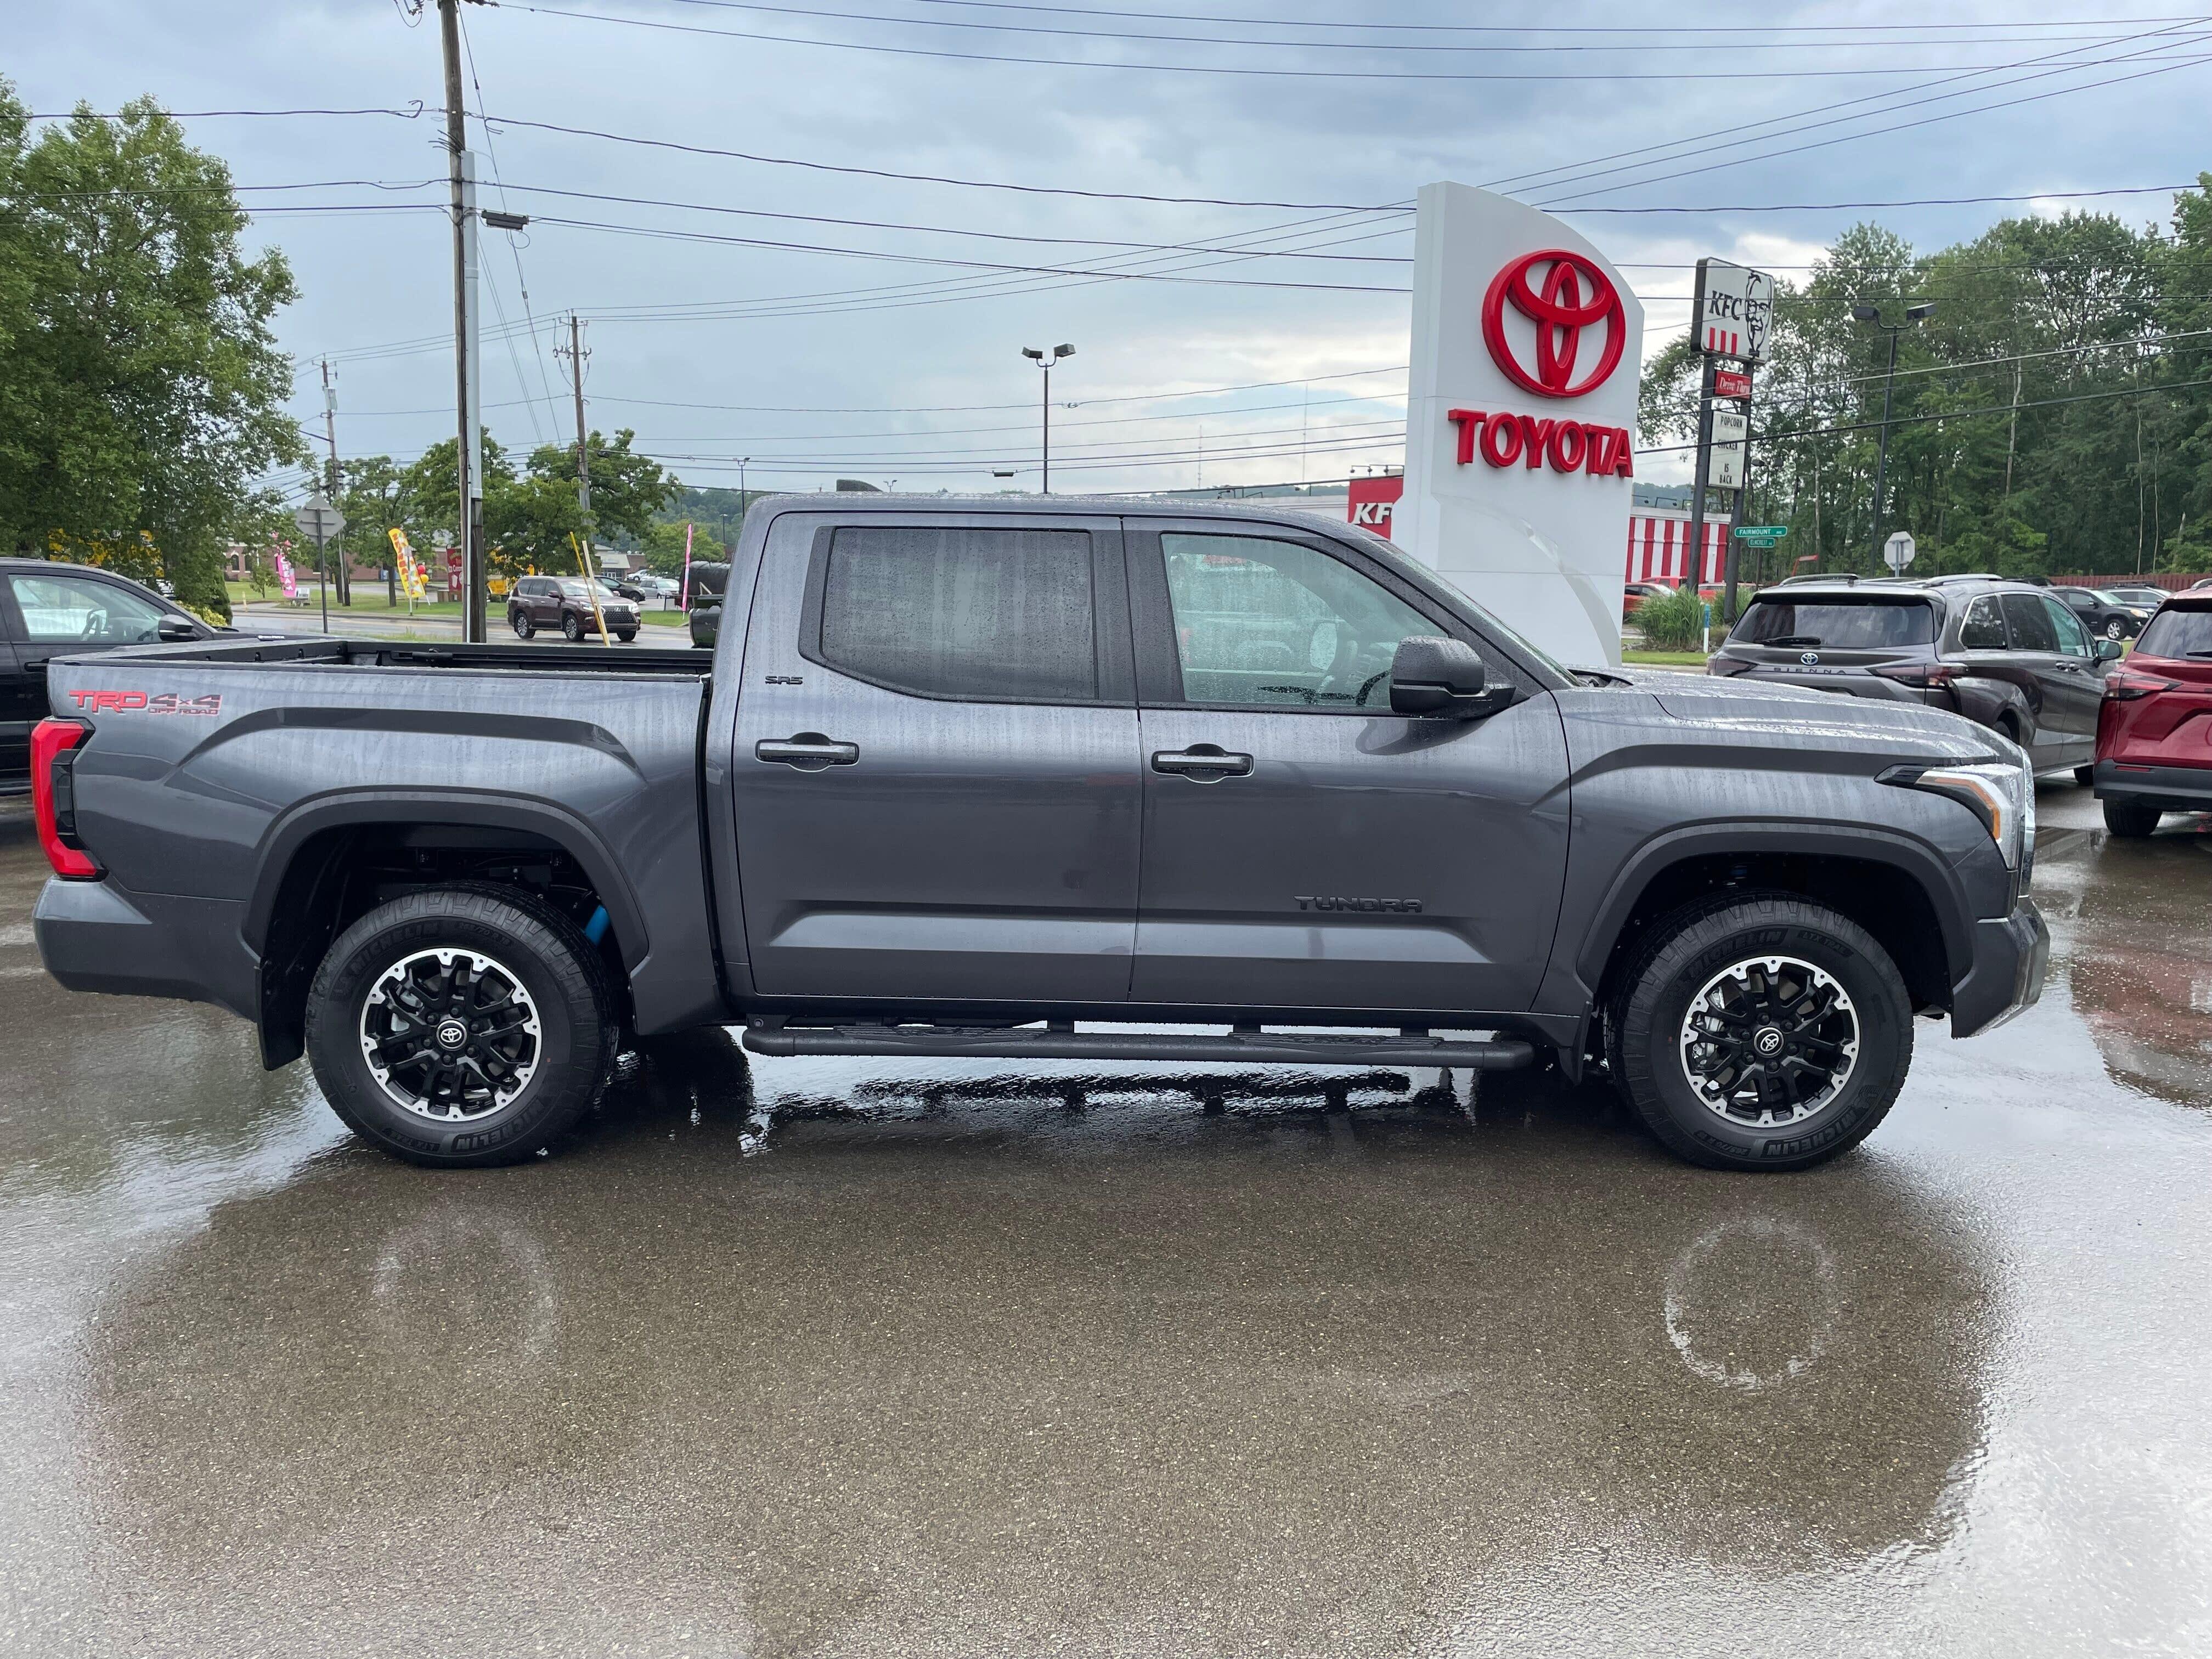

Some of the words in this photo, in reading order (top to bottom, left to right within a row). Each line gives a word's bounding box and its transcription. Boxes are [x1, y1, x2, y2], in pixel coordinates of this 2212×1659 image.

[1709, 290, 1742, 321] KFC
[1720, 377, 1735, 391] Drive
[1720, 416, 1742, 428] POPCORN
[1448, 409, 1633, 478] TOYOTA
[1724, 463, 1729, 472] IS
[1719, 475, 1732, 484] BACK
[1351, 503, 1393, 524] KF
[765, 675, 803, 685] SR5
[69, 690, 149, 714] TRD
[1293, 895, 1423, 913] TUNDRA
[350, 923, 438, 970] MICHELIN
[1689, 929, 1783, 974] MICHELIN
[456, 1098, 545, 1150] MICHELIN
[1768, 1110, 1857, 1155] MICHELIN
